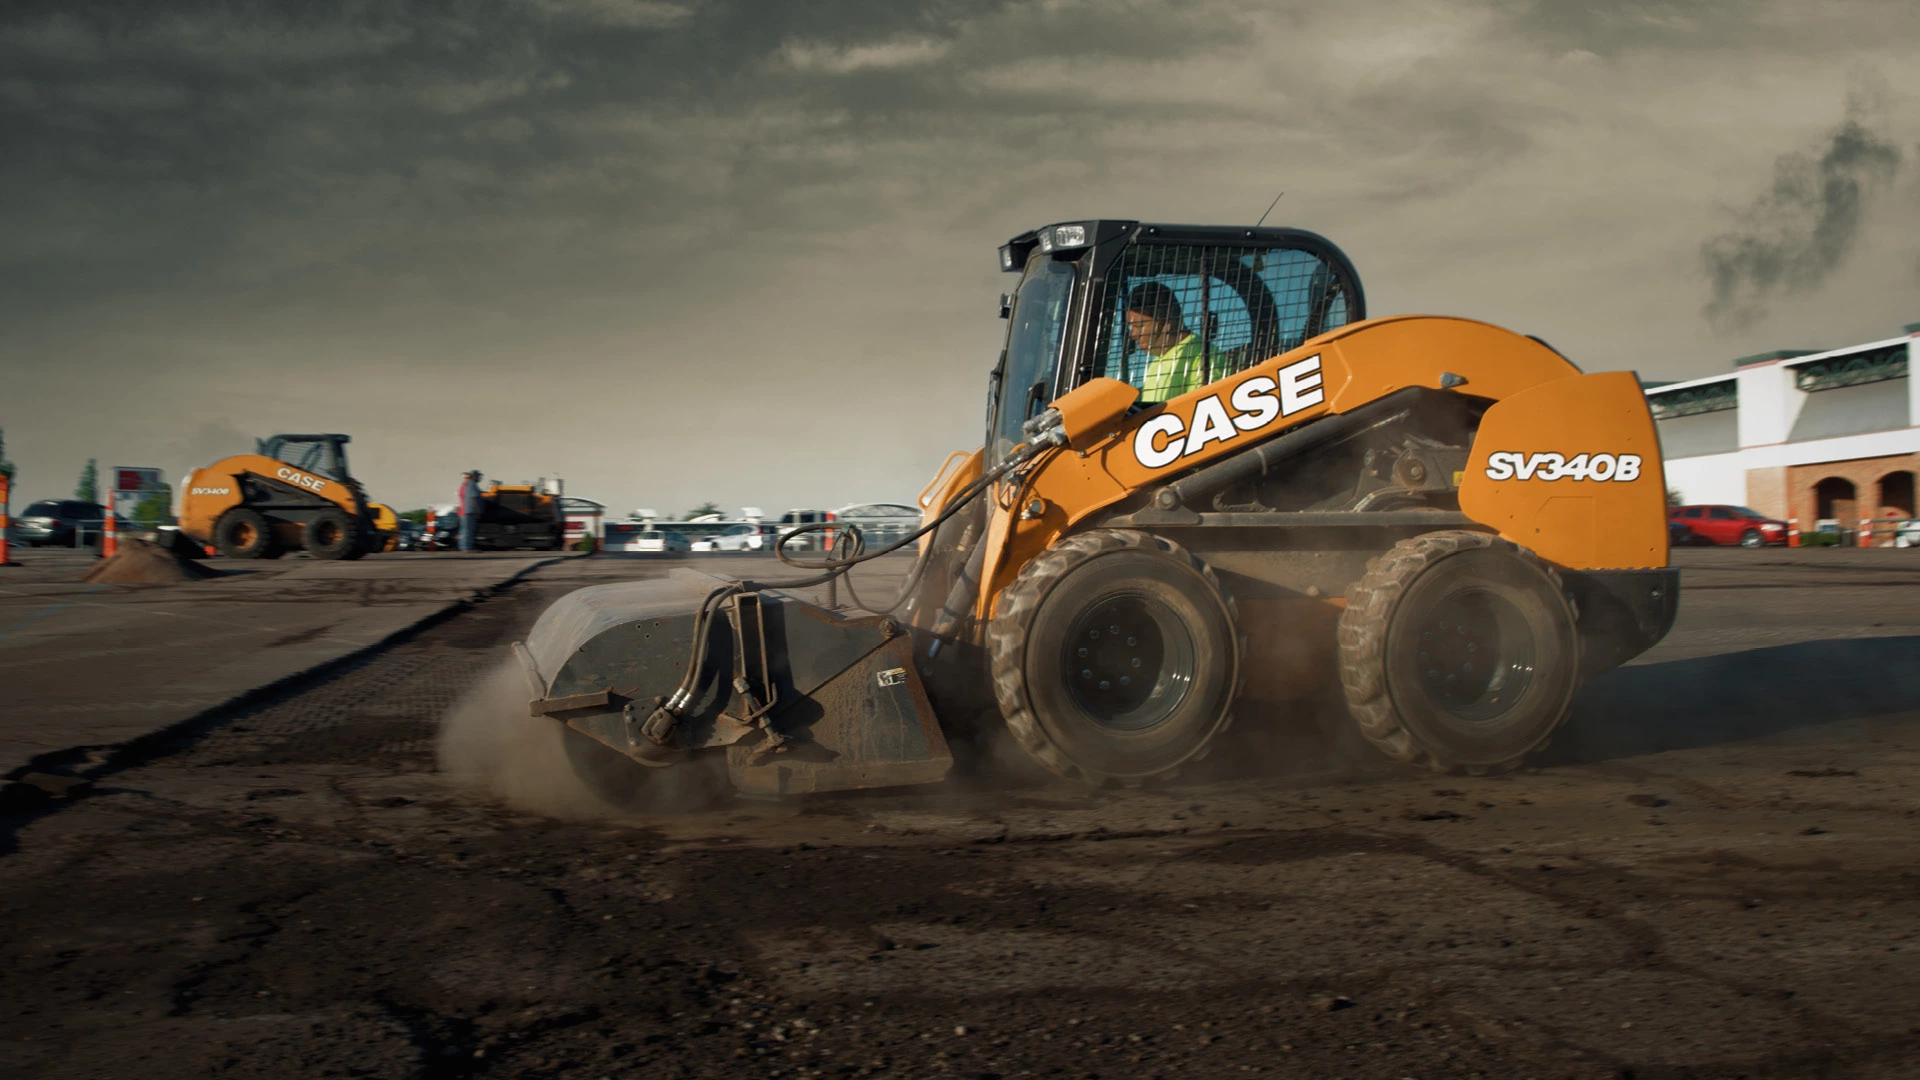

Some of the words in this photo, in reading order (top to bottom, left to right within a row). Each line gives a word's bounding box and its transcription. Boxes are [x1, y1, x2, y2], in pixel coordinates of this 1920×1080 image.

[1134, 353, 1324, 469] CASE
[277, 467, 326, 492] CASE
[1485, 451, 1642, 482] SV340B
